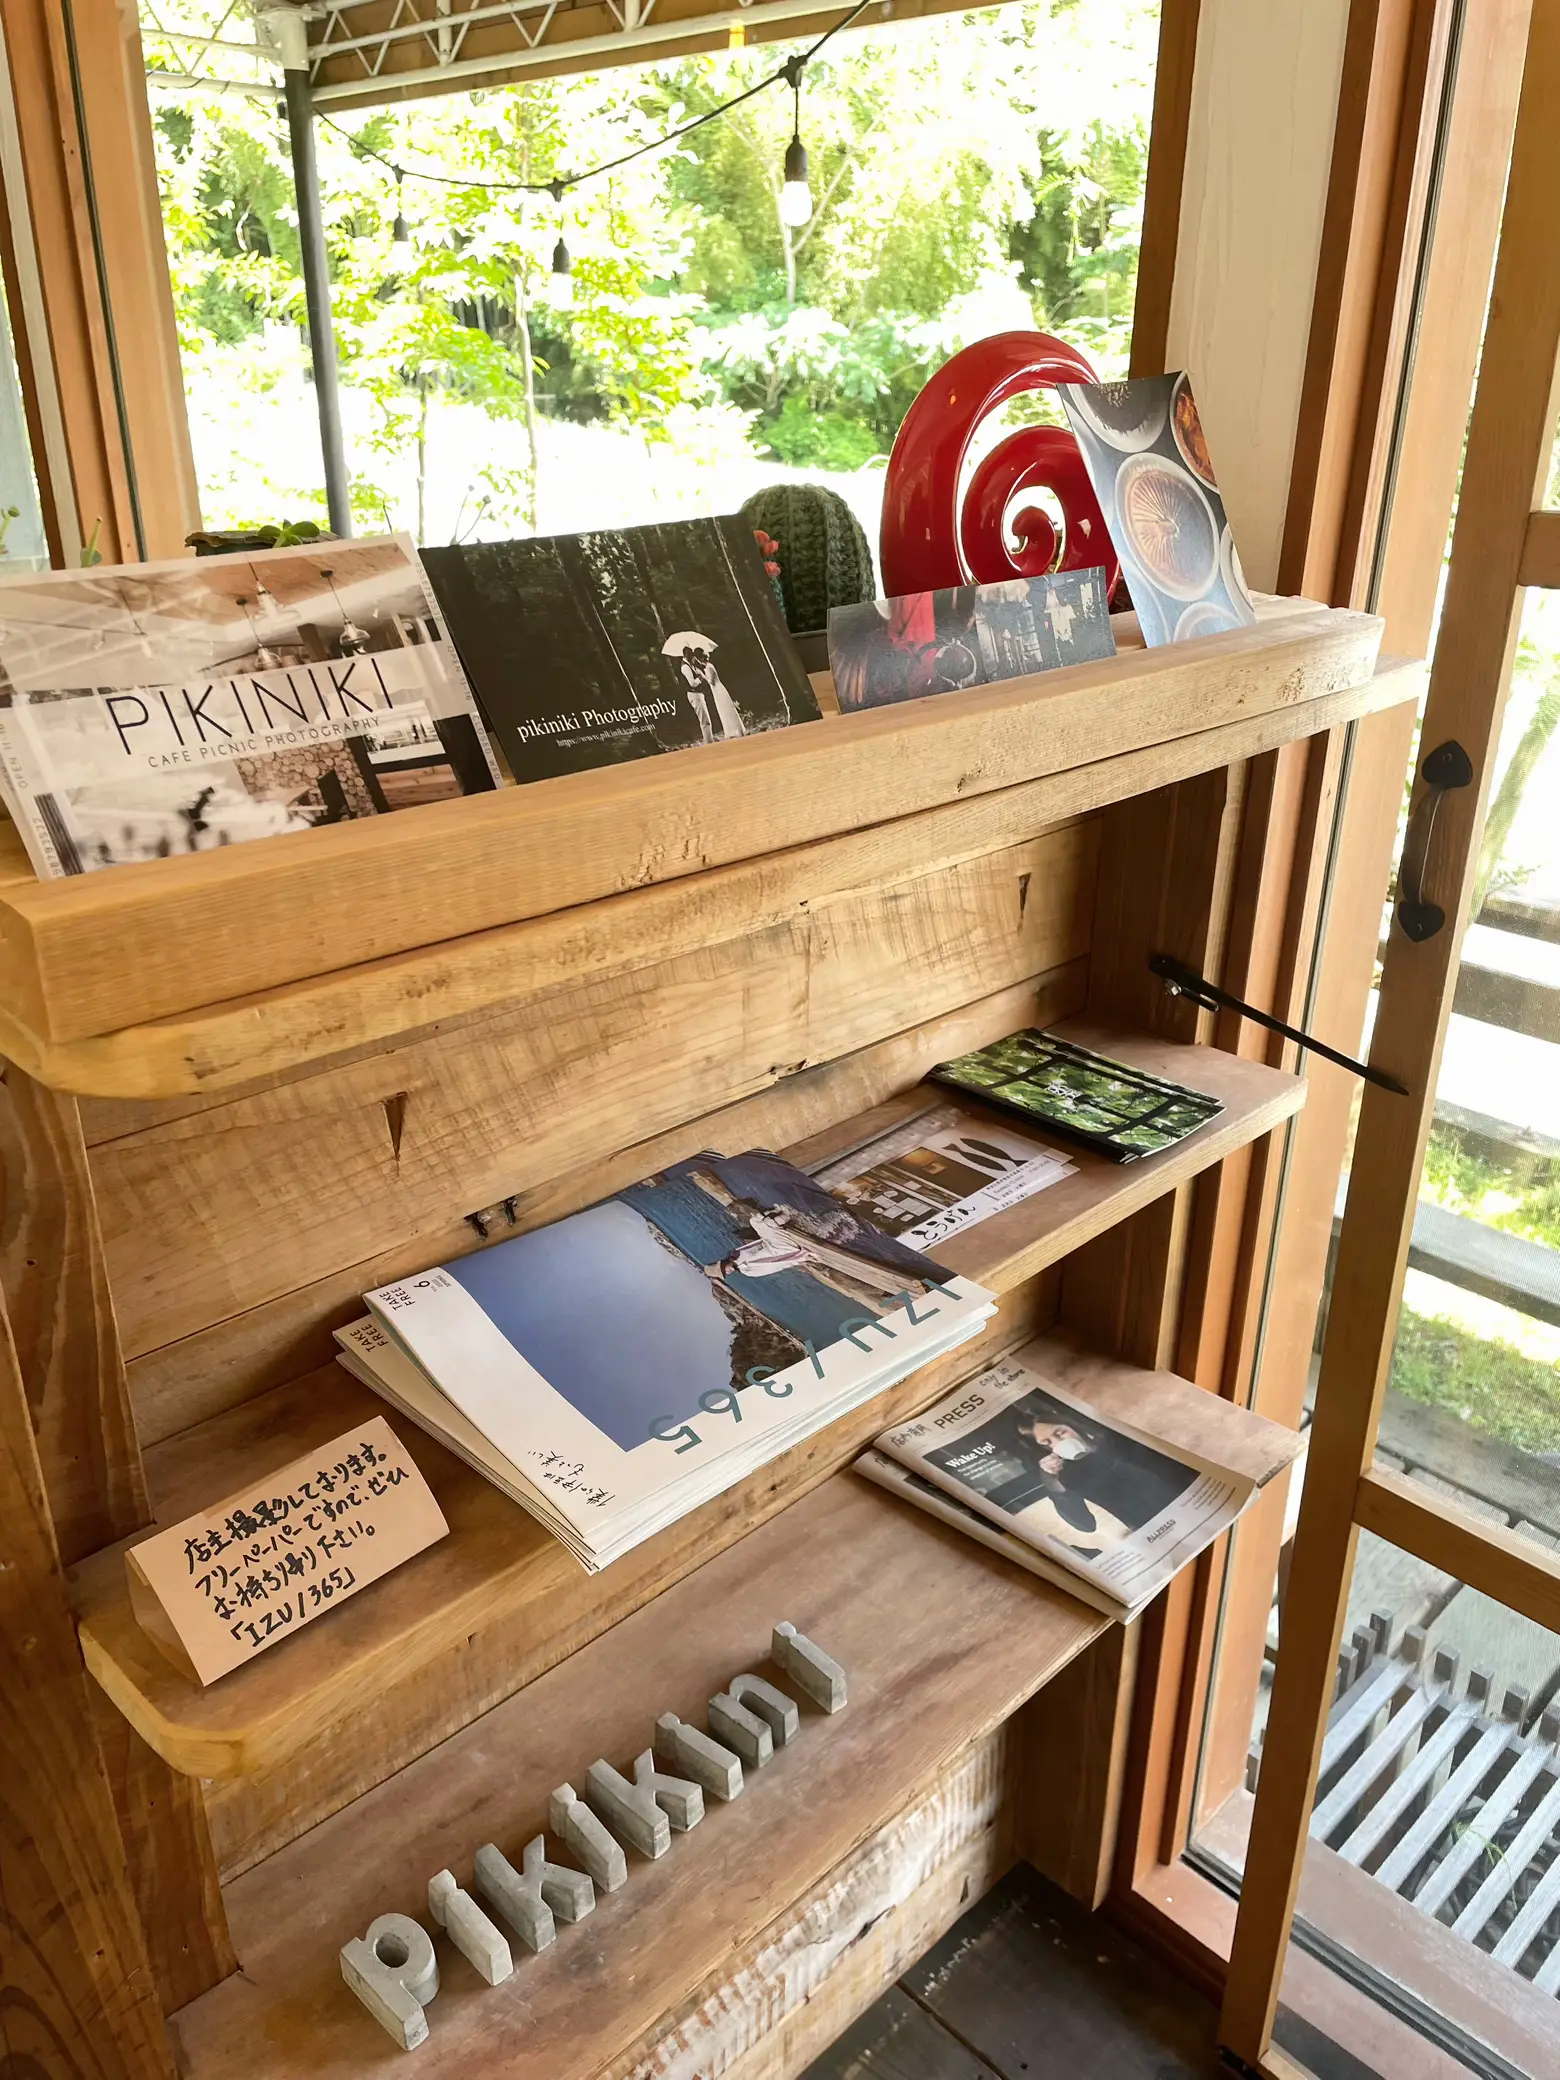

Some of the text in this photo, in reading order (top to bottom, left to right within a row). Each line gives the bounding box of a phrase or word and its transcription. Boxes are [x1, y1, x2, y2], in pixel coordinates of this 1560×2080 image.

[447, 645, 462, 672] OPEN
[105, 657, 394, 756] PIKINIKI
[517, 698, 677, 743] pikiniki Photography
[147, 716, 381, 768] CAFE PICNIC PHOTOGRAPHY
[472, 714, 491, 754] CLOSED
[391, 1286, 416, 1306] FREE
[413, 1280, 430, 1288] 6
[379, 1292, 402, 1311] TAKE
[350, 1329, 376, 1352] TAKE
[361, 1323, 388, 1347] FREE
[933, 1393, 986, 1429] PRESS
[945, 1449, 974, 1468] Wake
[974, 1442, 996, 1455] Up!
[1146, 1518, 1177, 1543] ALLPRESS
